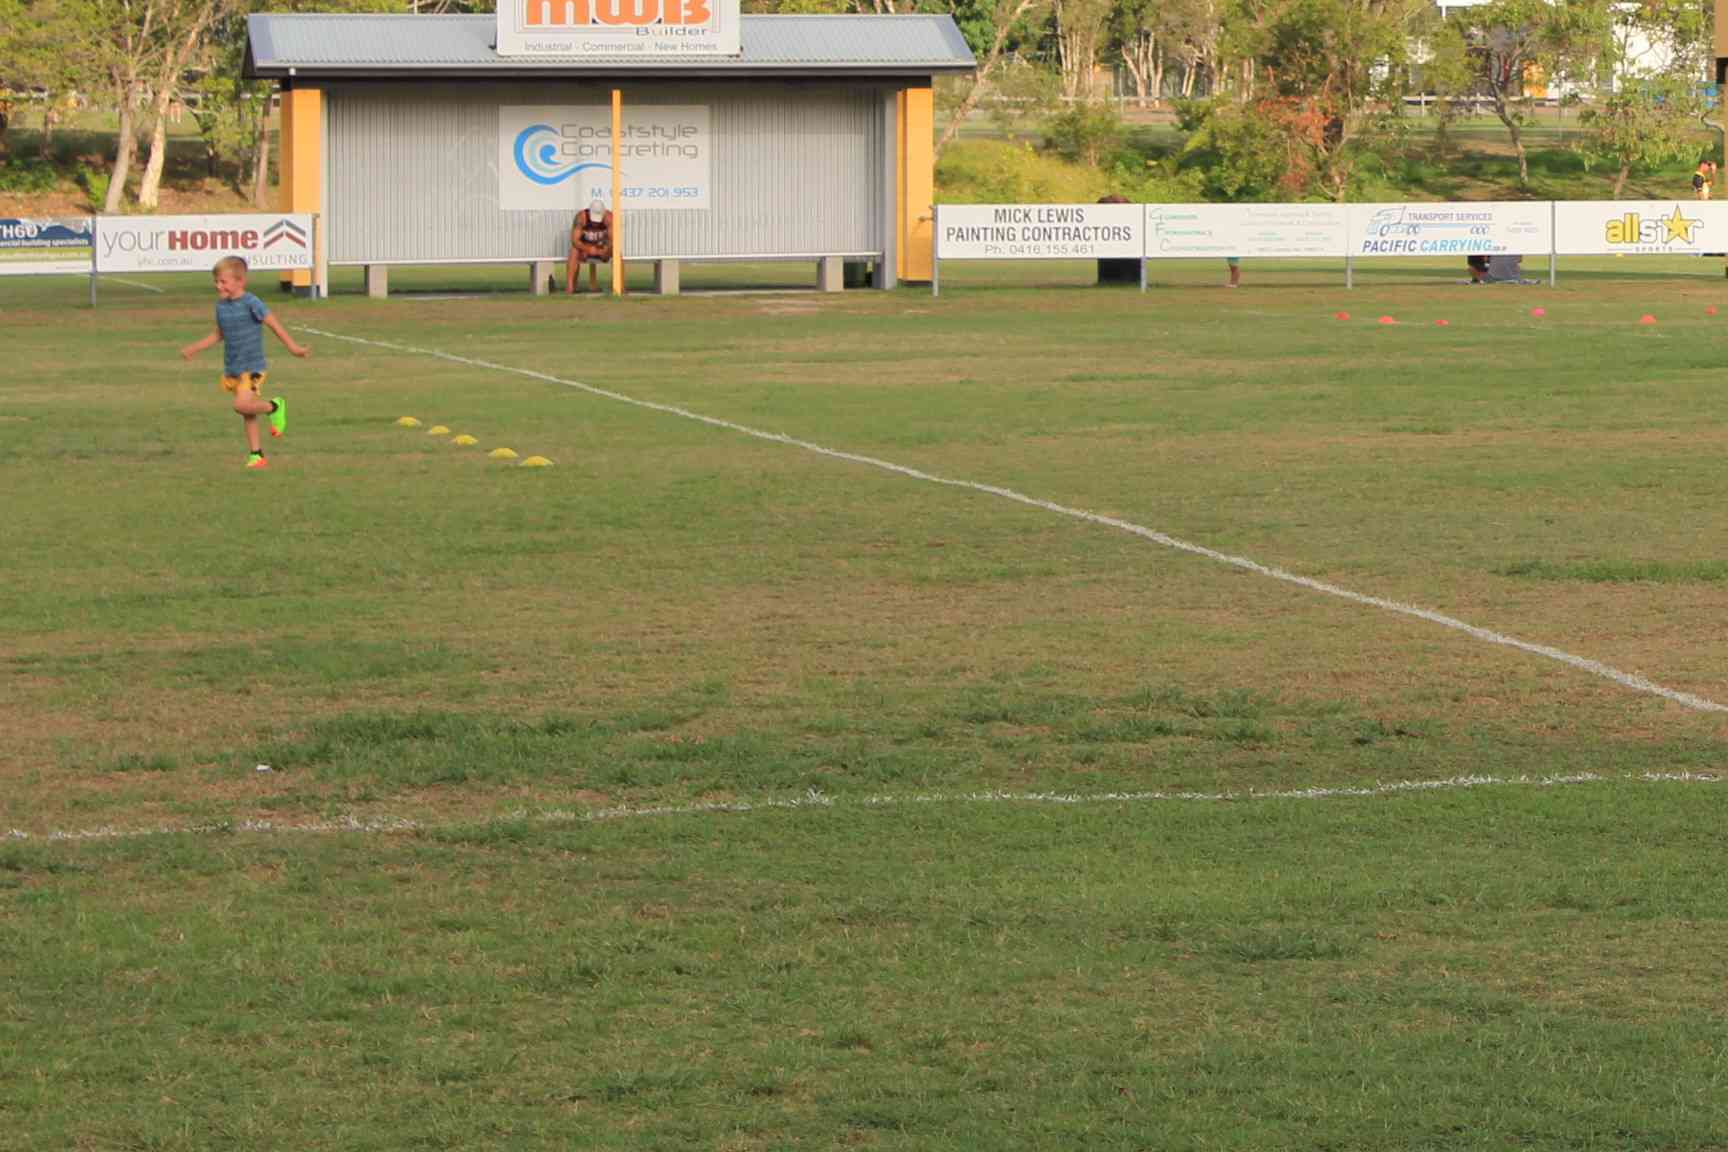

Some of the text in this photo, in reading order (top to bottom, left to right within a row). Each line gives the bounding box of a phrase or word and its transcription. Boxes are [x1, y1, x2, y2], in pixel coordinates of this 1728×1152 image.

[636, 26, 706, 37] Builder
[524, 40, 717, 51] Industrial Commercial New Homes
[672, 187, 698, 198] 953
[993, 208, 1085, 224] MICK LEWIS
[1408, 212, 1493, 221] TRANSPORT SERVICES
[946, 227, 1131, 241] PAINTING CONTRACTORS
[1009, 244, 1041, 255] 0416
[1047, 244, 1068, 255] 155
[1072, 244, 1095, 255] 461
[1362, 240, 1417, 253] PACIFIC
[1420, 239, 1494, 252] CARRYING
